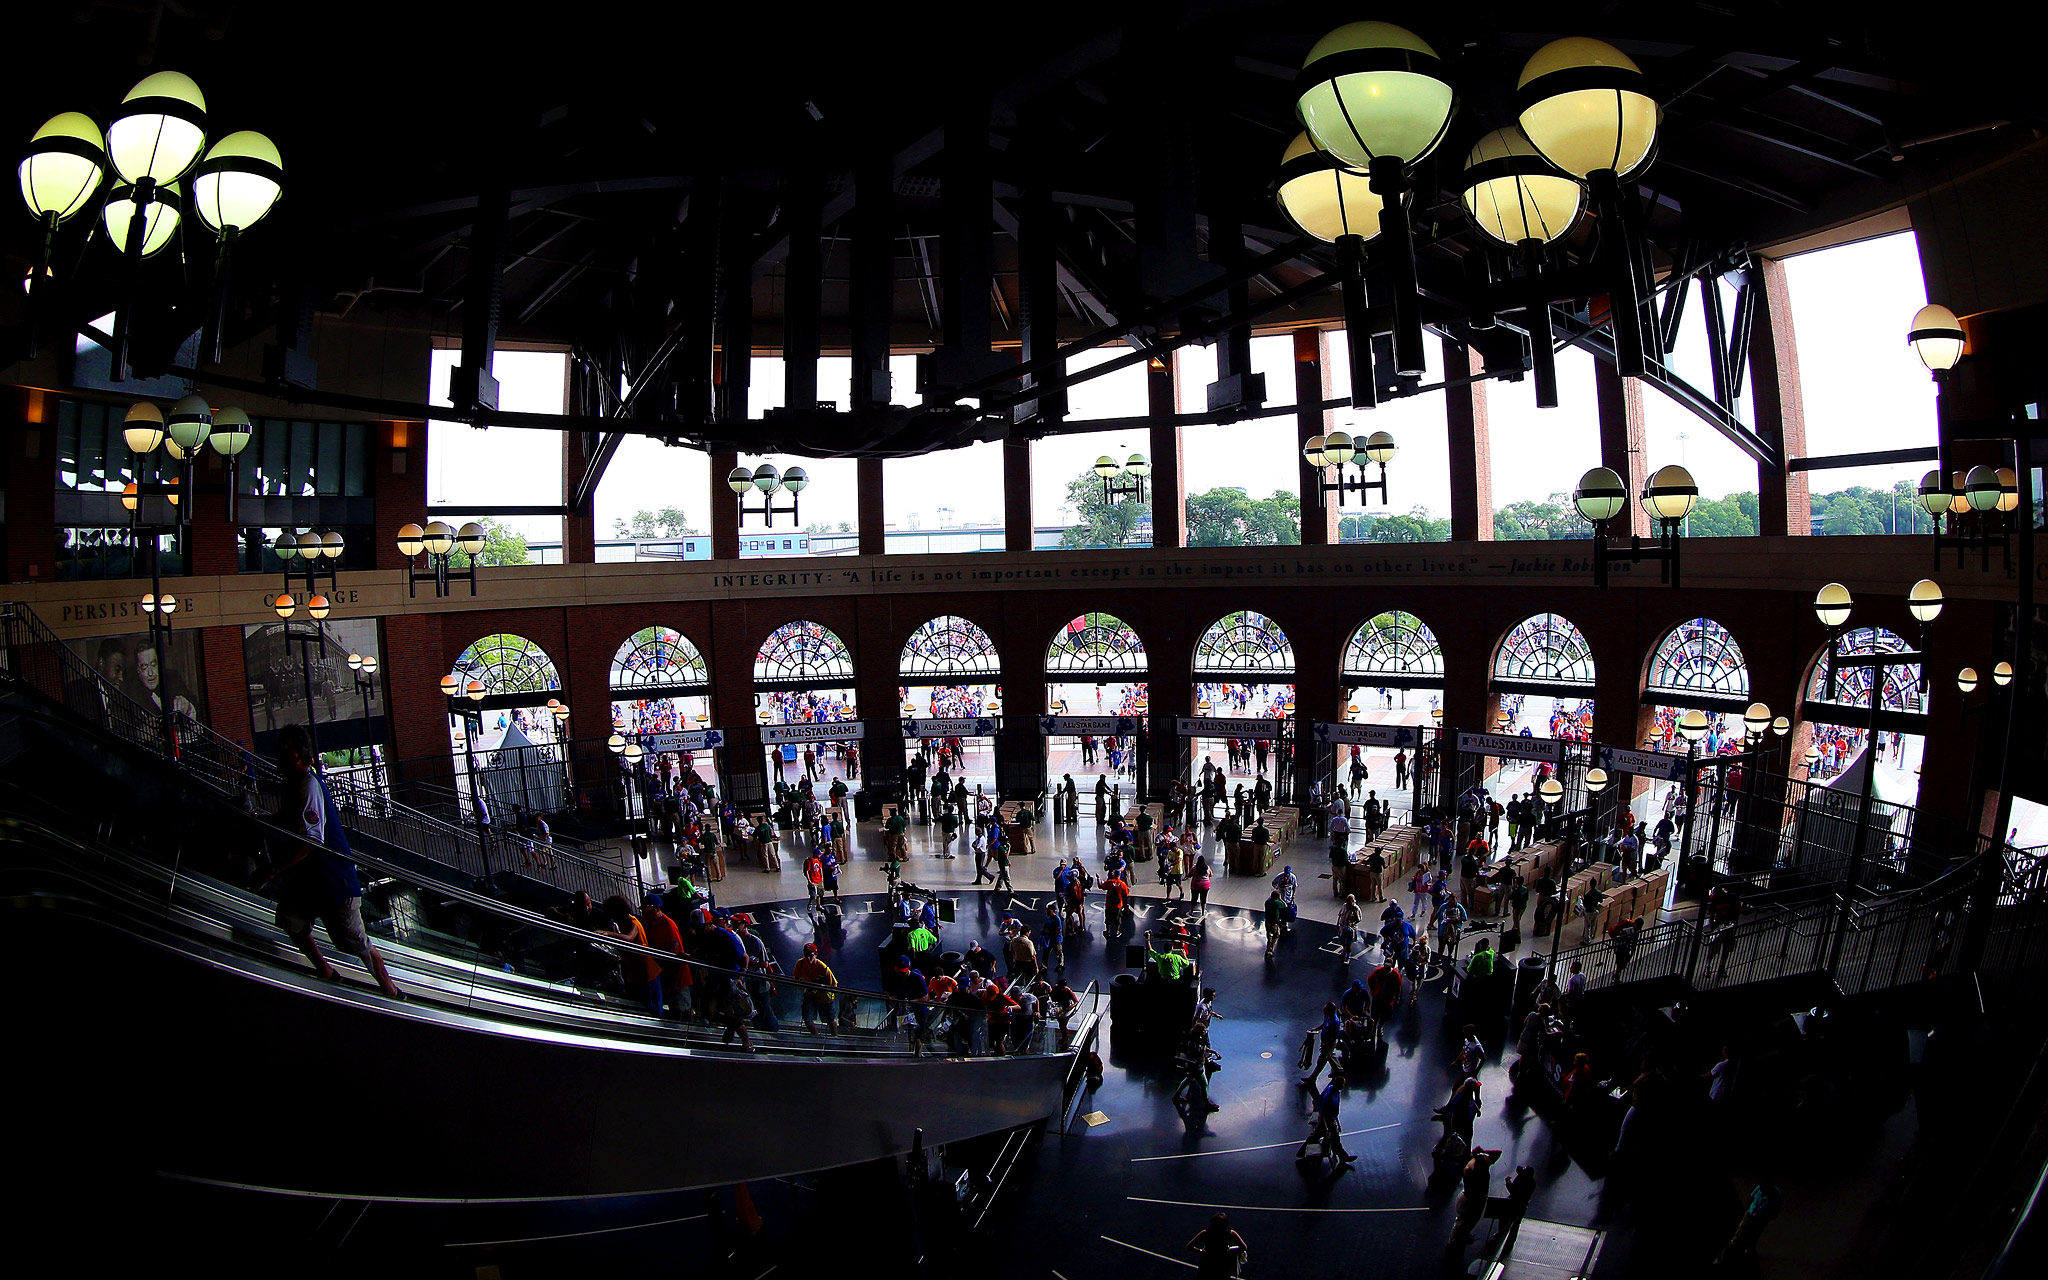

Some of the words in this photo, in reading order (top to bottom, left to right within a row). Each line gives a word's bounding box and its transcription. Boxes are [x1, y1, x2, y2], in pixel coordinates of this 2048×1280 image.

[713, 572, 832, 587] INTEGRITY:
[872, 570, 902, 582] life
[911, 571, 925, 581] is
[934, 570, 962, 581] not
[972, 568, 1061, 583] important
[1071, 566, 1130, 581] except
[1140, 565, 1155, 576] in
[1166, 563, 1192, 575] the
[1202, 563, 1263, 578] impact
[1273, 562, 1286, 574] it
[1296, 561, 1324, 573] has
[1334, 562, 1354, 573] on
[1364, 560, 1412, 573] other
[1561, 558, 1632, 573] Robison
[63, 598, 194, 621] PERSISTCE
[830, 725, 857, 735] GAME
[1243, 722, 1272, 733] GAME
